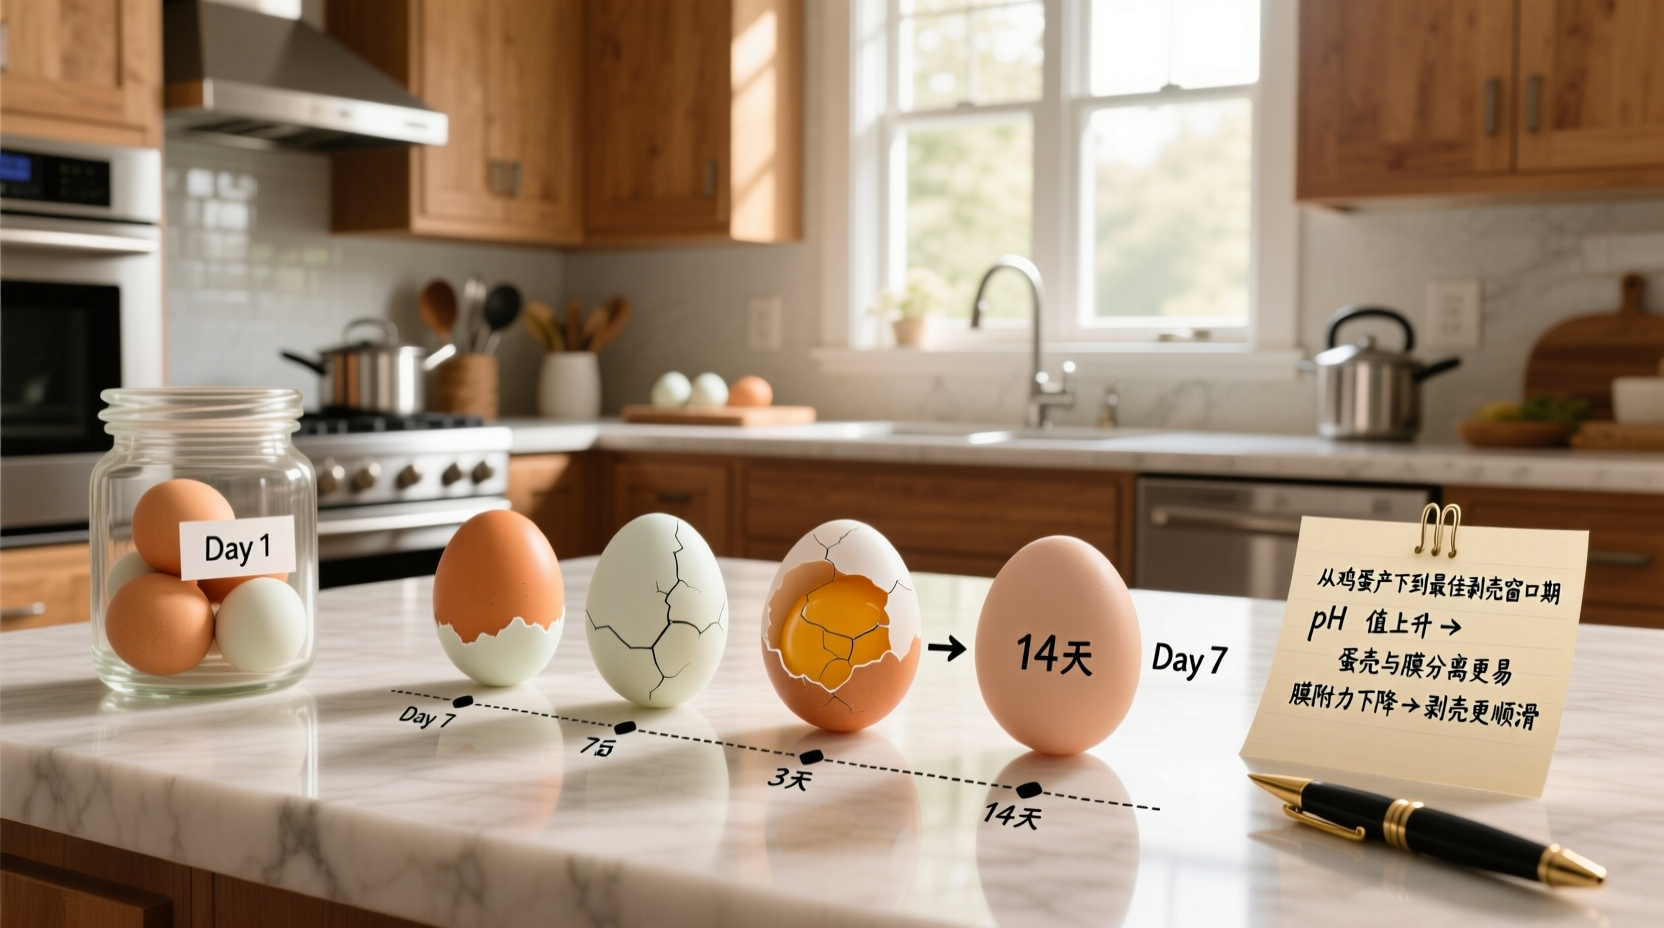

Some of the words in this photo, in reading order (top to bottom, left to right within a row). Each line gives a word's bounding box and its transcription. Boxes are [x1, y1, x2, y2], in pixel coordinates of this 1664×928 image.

[205, 535, 254, 568] Day
[259, 533, 270, 557] 1
[1316, 566, 1562, 606] 从鸡蛋产下到最佳剥壳窗口期
[1307, 605, 1348, 642] pH
[1365, 607, 1433, 640] 值上升
[1016, 632, 1094, 678] 14天
[1151, 641, 1206, 682] Day
[1210, 645, 1230, 675] 7
[1338, 646, 1513, 688] 蛋壳与膜分离更易
[398, 705, 438, 730] Day
[440, 712, 457, 729] 7
[1288, 681, 1399, 718] 膜附力下降
[1423, 694, 1540, 732] 剥壳更顺滑
[767, 767, 814, 792] 3天
[983, 801, 1043, 831] 14天
